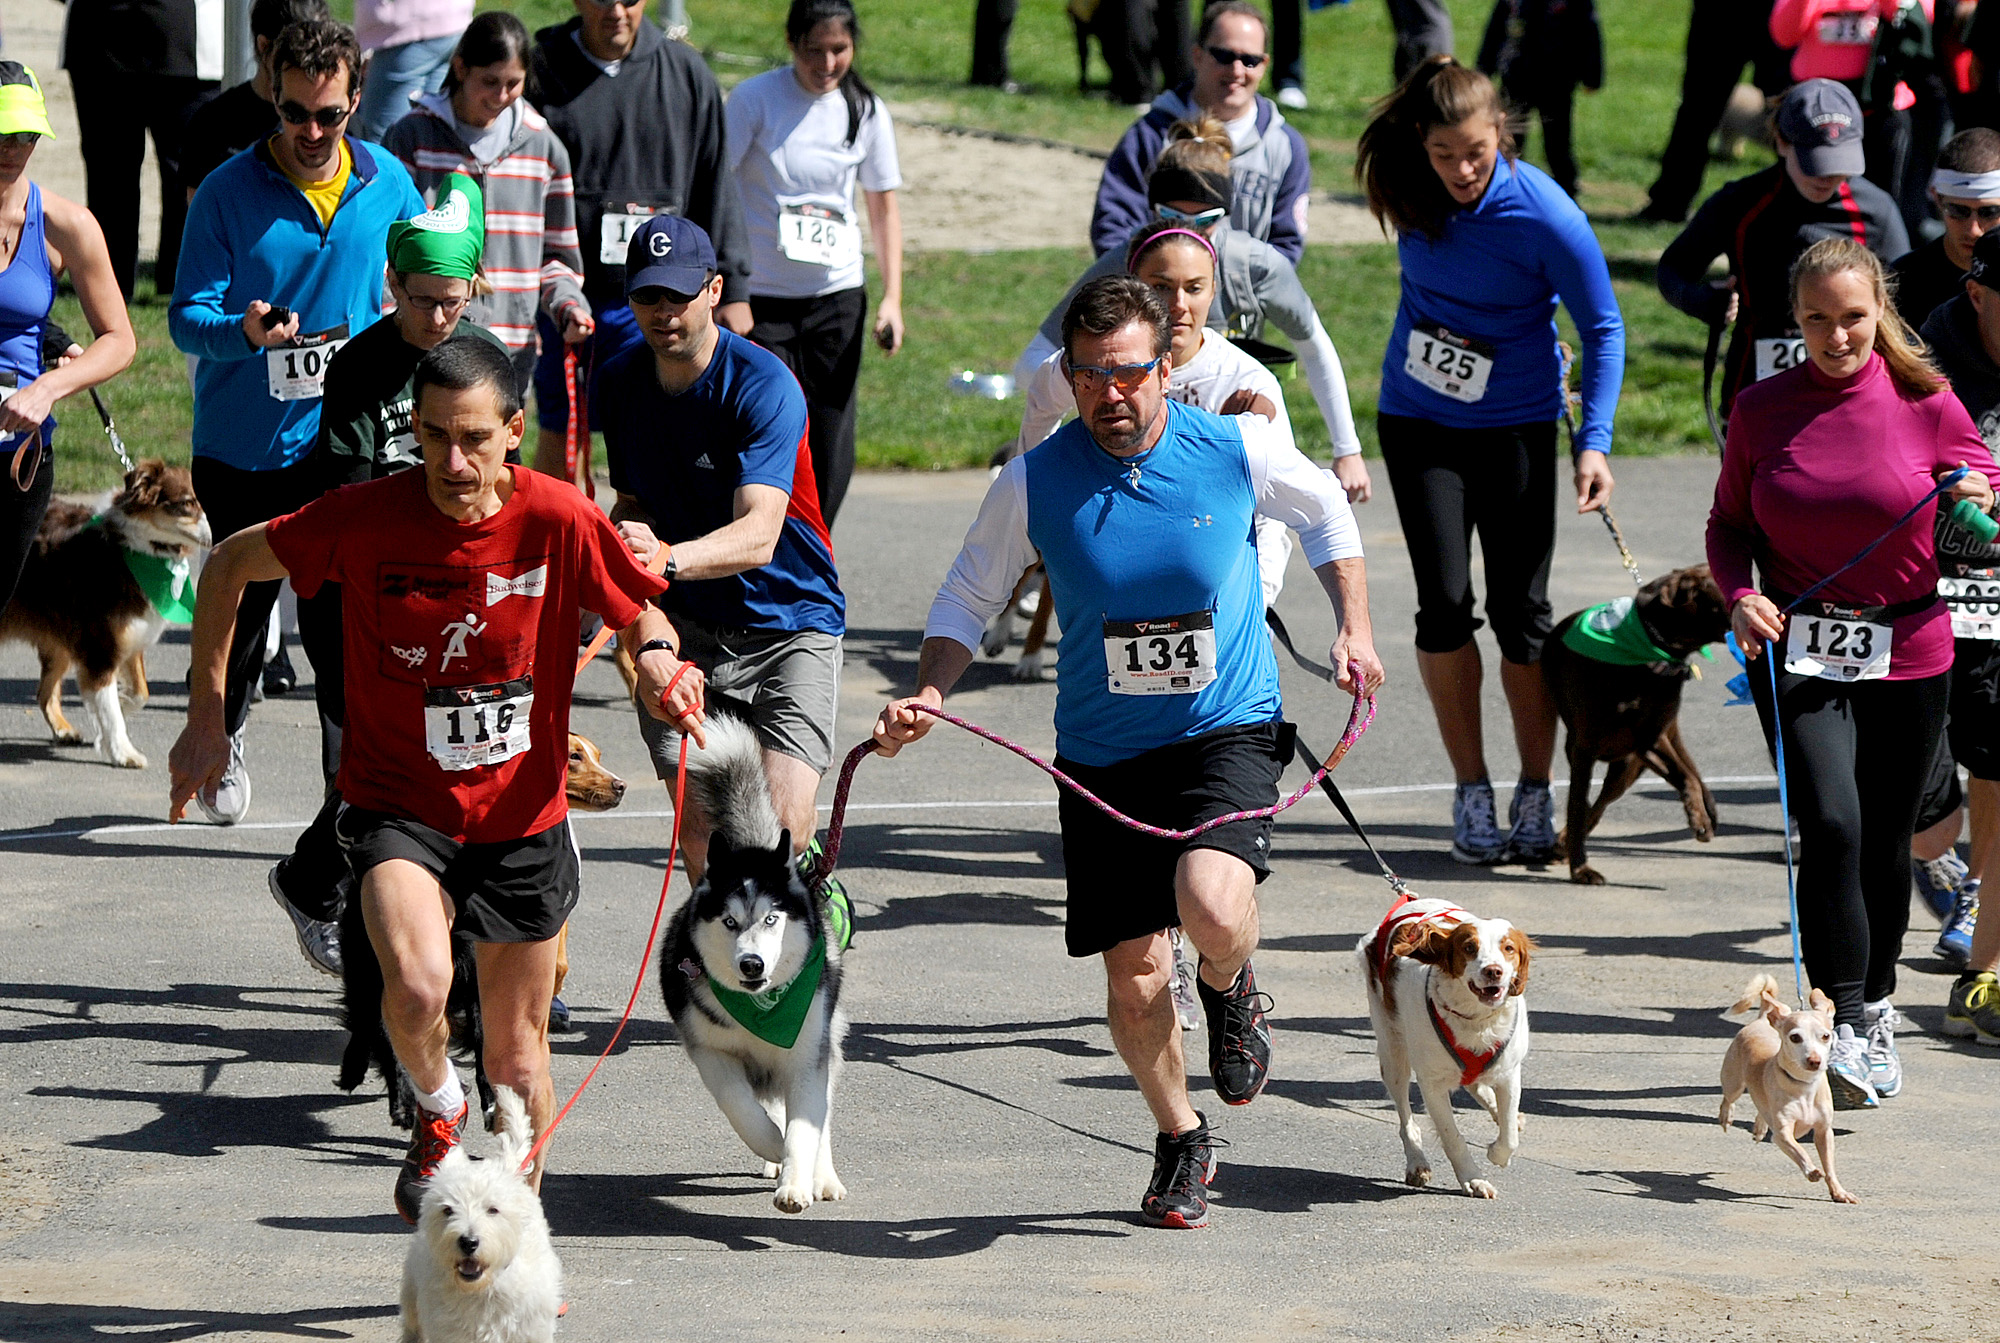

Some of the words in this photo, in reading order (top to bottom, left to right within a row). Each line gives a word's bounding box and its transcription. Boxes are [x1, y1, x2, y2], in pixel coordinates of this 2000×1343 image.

[649, 232, 672, 257] C
[796, 220, 837, 248] 126
[1421, 341, 1478, 381] 125
[381, 398, 416, 422] ANIM
[489, 579, 544, 594] Budweiser
[1125, 634, 1200, 672] 134
[1806, 620, 1873, 660] 123
[1130, 670, 1193, 678] www.RoadID.com
[446, 703, 517, 744] 116
